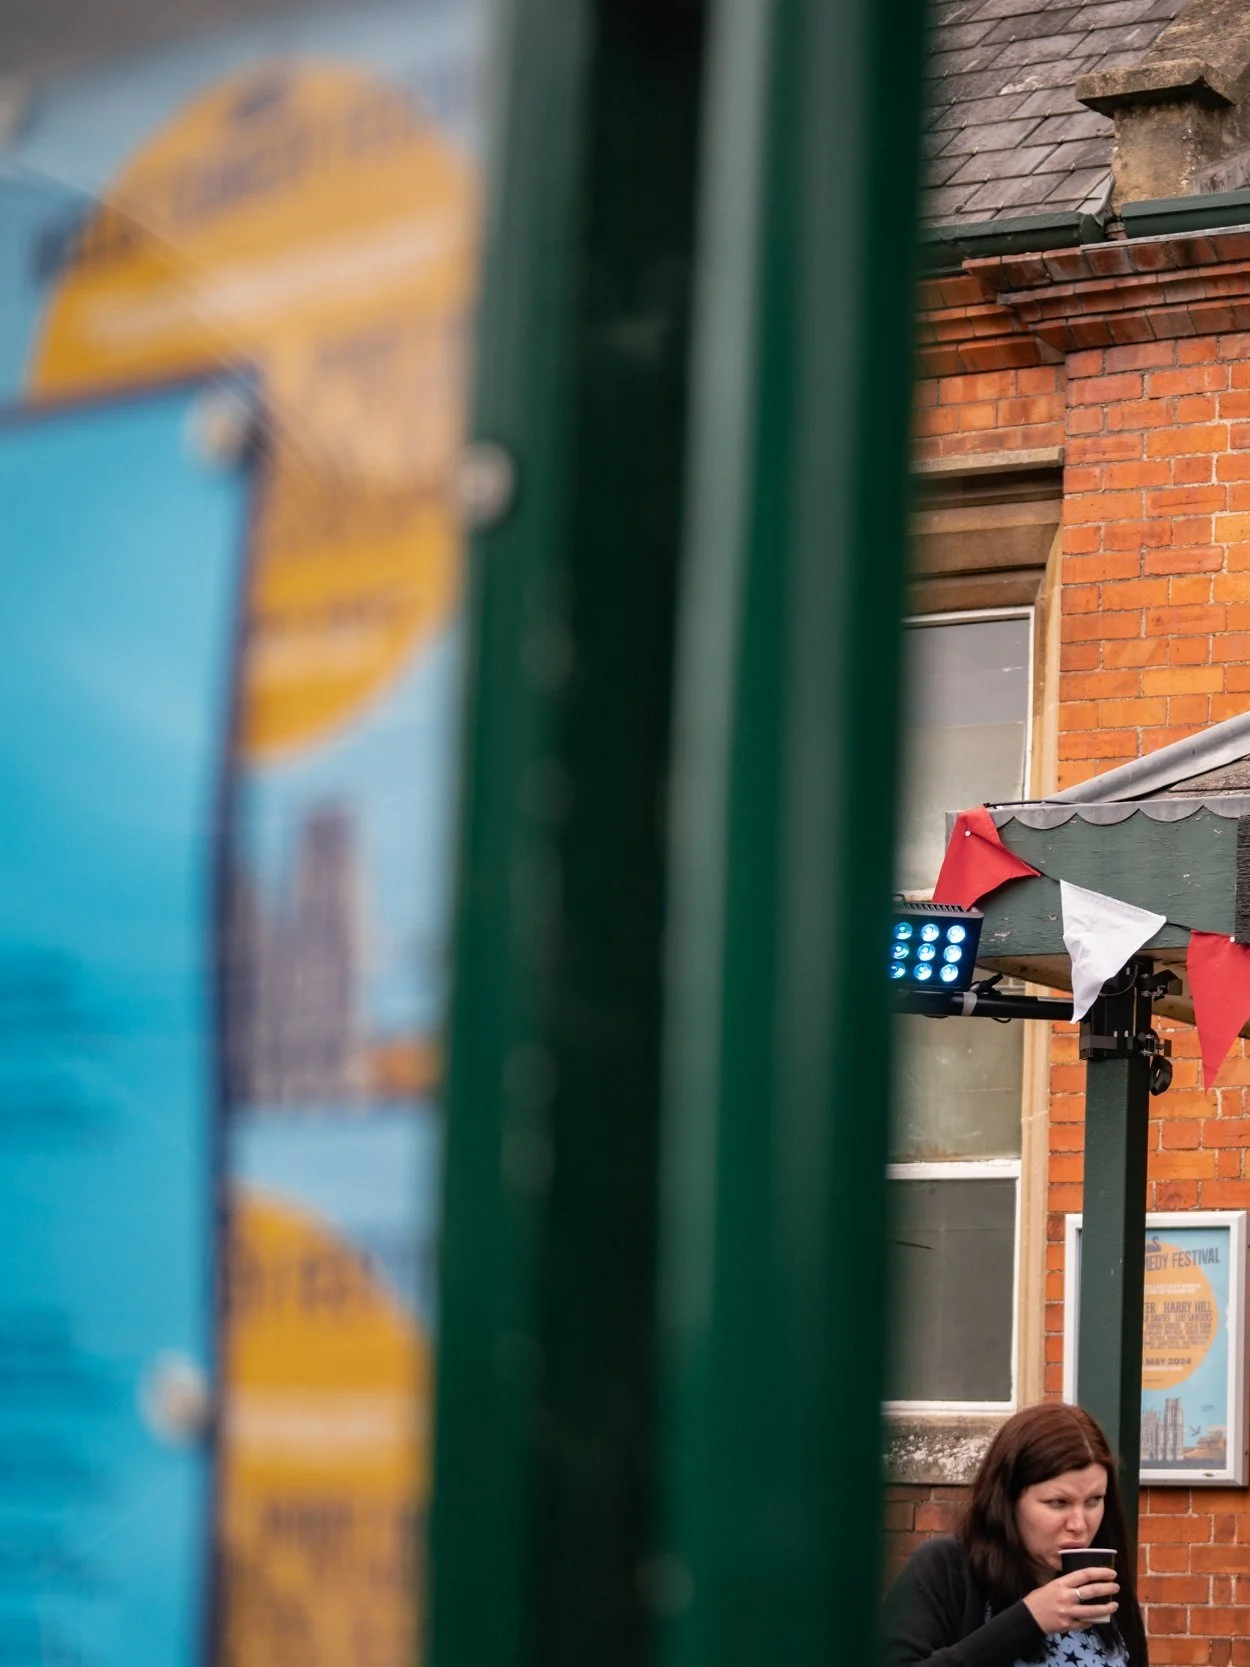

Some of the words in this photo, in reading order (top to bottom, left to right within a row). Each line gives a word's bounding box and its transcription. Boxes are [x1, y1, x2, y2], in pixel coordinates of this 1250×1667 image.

[1172, 1247, 1221, 1269] FESTIVAL
[1163, 1301, 1191, 1313] HARRY
[1194, 1300, 1213, 1312] HILL
[1167, 1357, 1192, 1365] 2024
